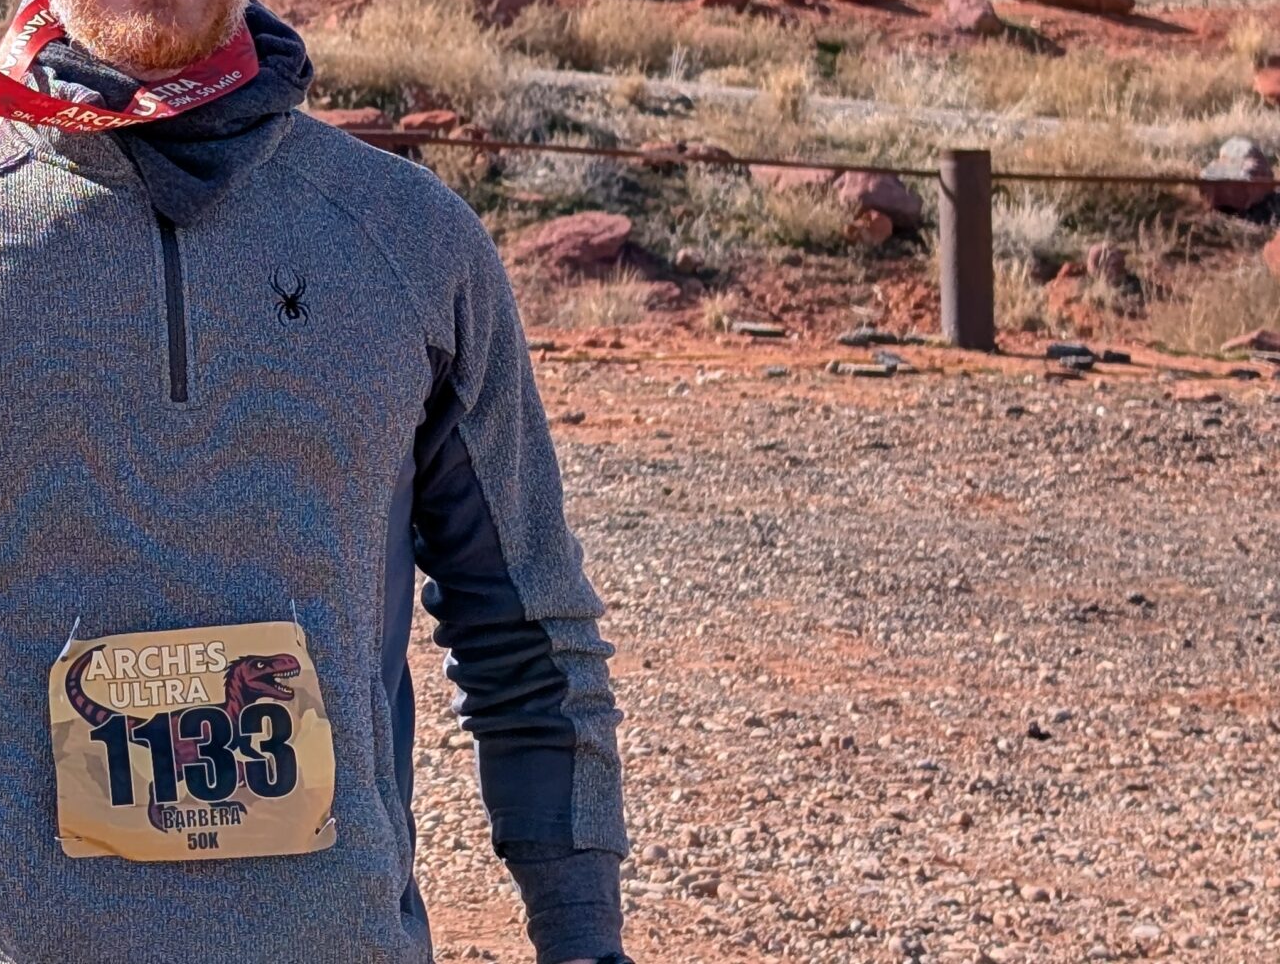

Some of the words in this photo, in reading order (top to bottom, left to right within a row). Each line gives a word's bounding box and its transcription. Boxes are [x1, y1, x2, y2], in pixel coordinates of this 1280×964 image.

[0, 9, 55, 75] JANUA
[132, 78, 203, 117] ULTRA
[196, 86, 215, 97] 50
[213, 70, 243, 90] Mile
[86, 641, 227, 681] ARCHES
[109, 678, 210, 707] ULTRA
[90, 703, 299, 807] 1133
[163, 807, 242, 831] BARBERA
[187, 832, 219, 850] 50K
